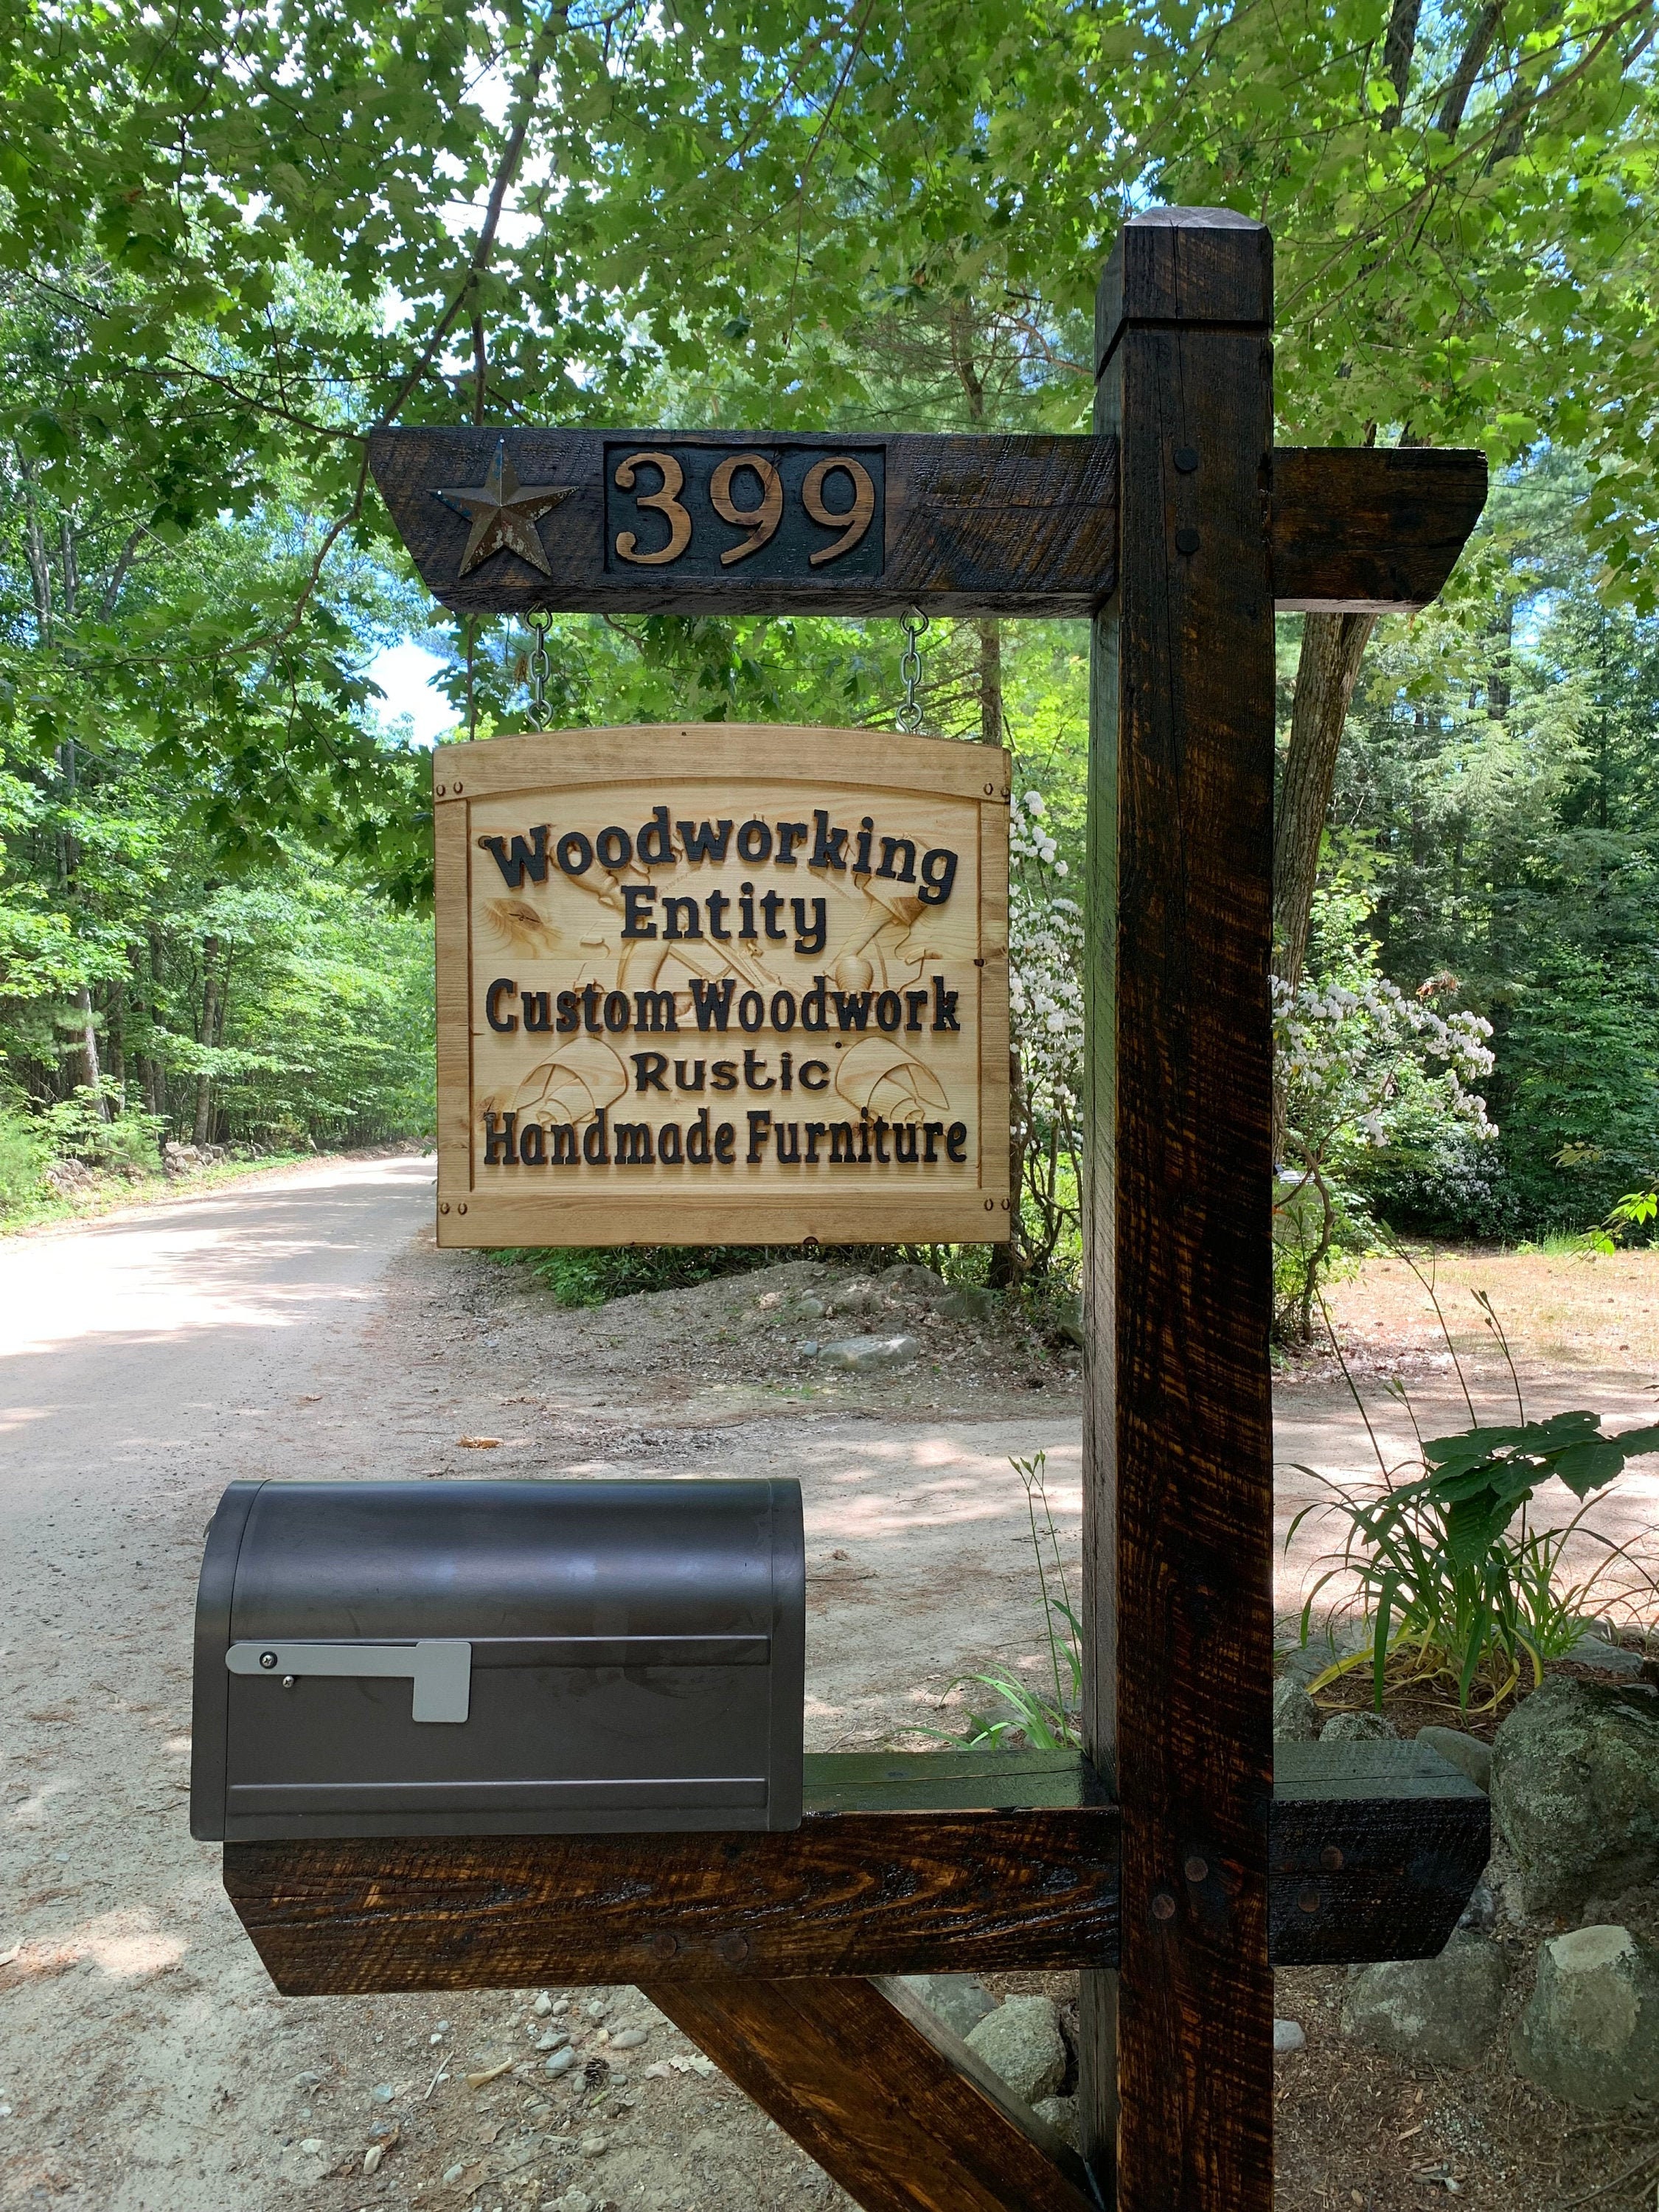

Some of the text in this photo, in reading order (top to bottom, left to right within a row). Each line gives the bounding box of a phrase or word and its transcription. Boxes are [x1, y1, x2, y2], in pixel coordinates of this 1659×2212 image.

[614, 451, 875, 566] 399
[487, 806, 959, 905] Woodworking
[620, 881, 827, 955] Entity
[485, 975, 961, 1033] Custom Woodwork
[630, 1048, 830, 1092] Rustic
[483, 1107, 967, 1166] Handmade Furniture
